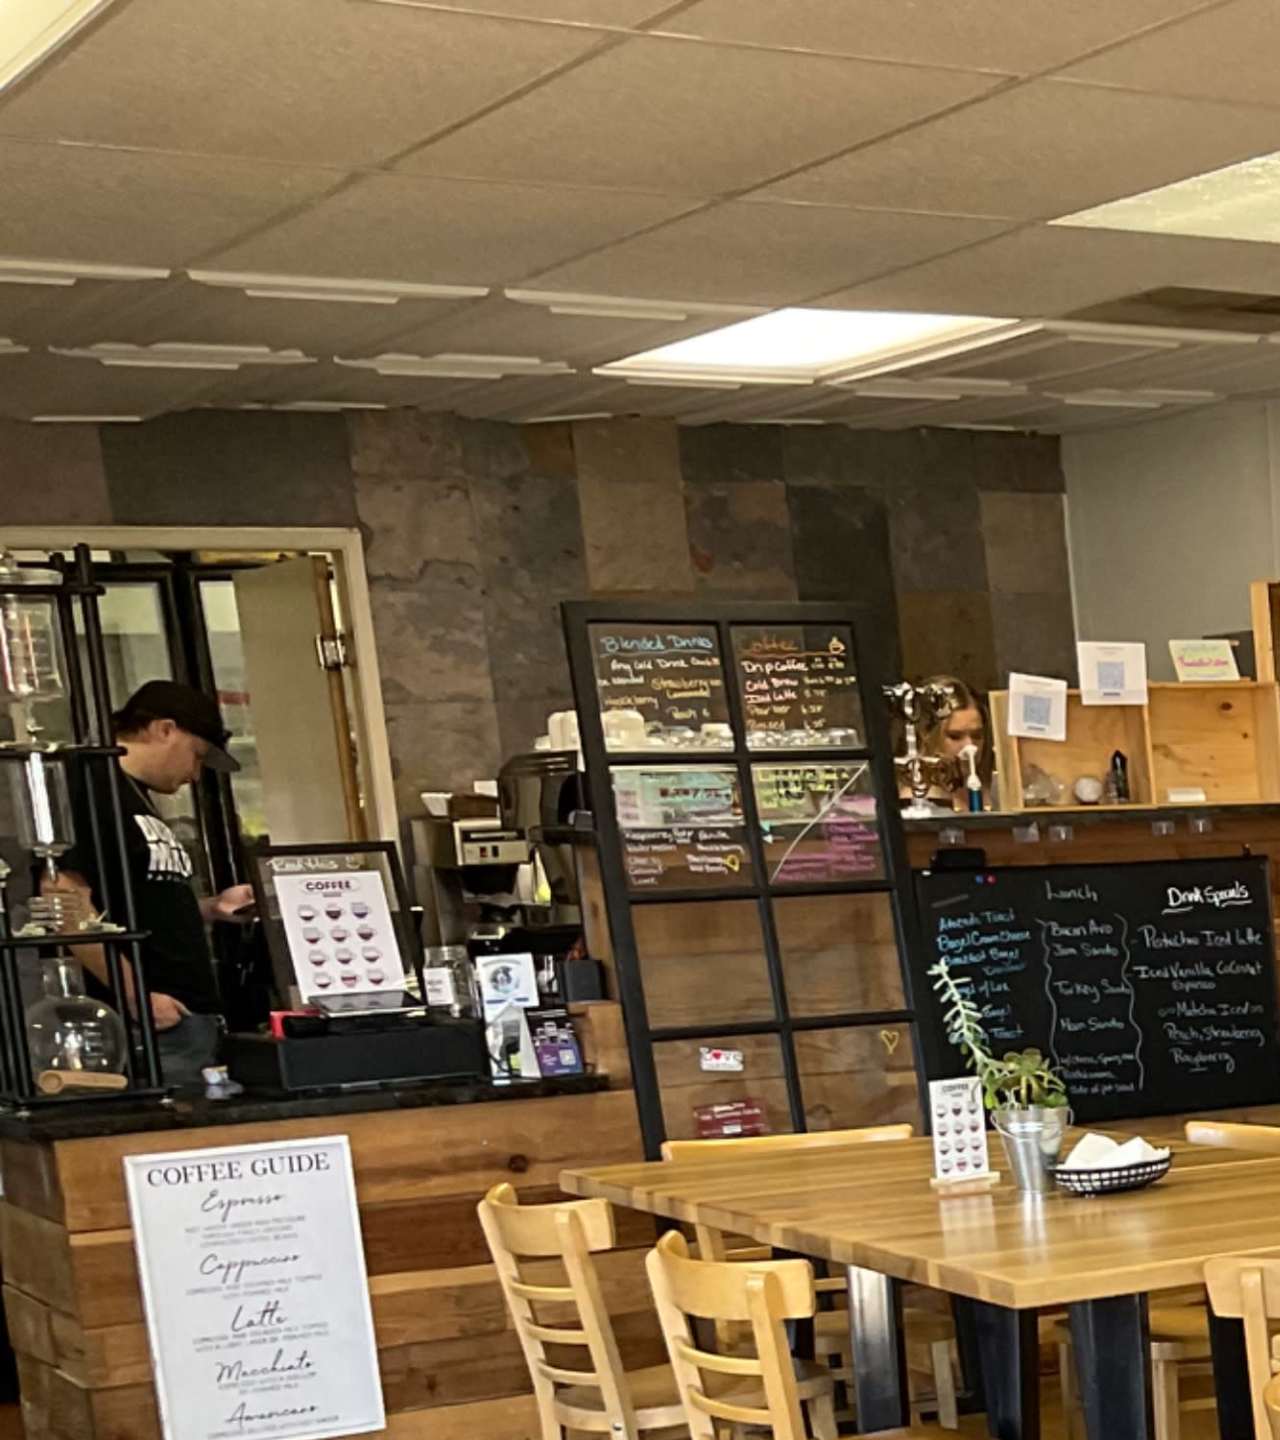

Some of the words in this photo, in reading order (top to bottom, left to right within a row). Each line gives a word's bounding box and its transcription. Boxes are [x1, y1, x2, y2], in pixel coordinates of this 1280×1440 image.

[305, 880, 352, 891] COFFEE
[146, 1159, 243, 1188] COFFEE
[250, 1151, 332, 1178] GUIDE
[199, 1188, 287, 1223] Espresso
[199, 1251, 300, 1285] Cappuccino
[230, 1299, 289, 1333] Latte
[215, 1348, 315, 1384] Macchiato
[224, 1401, 319, 1431] Americano
